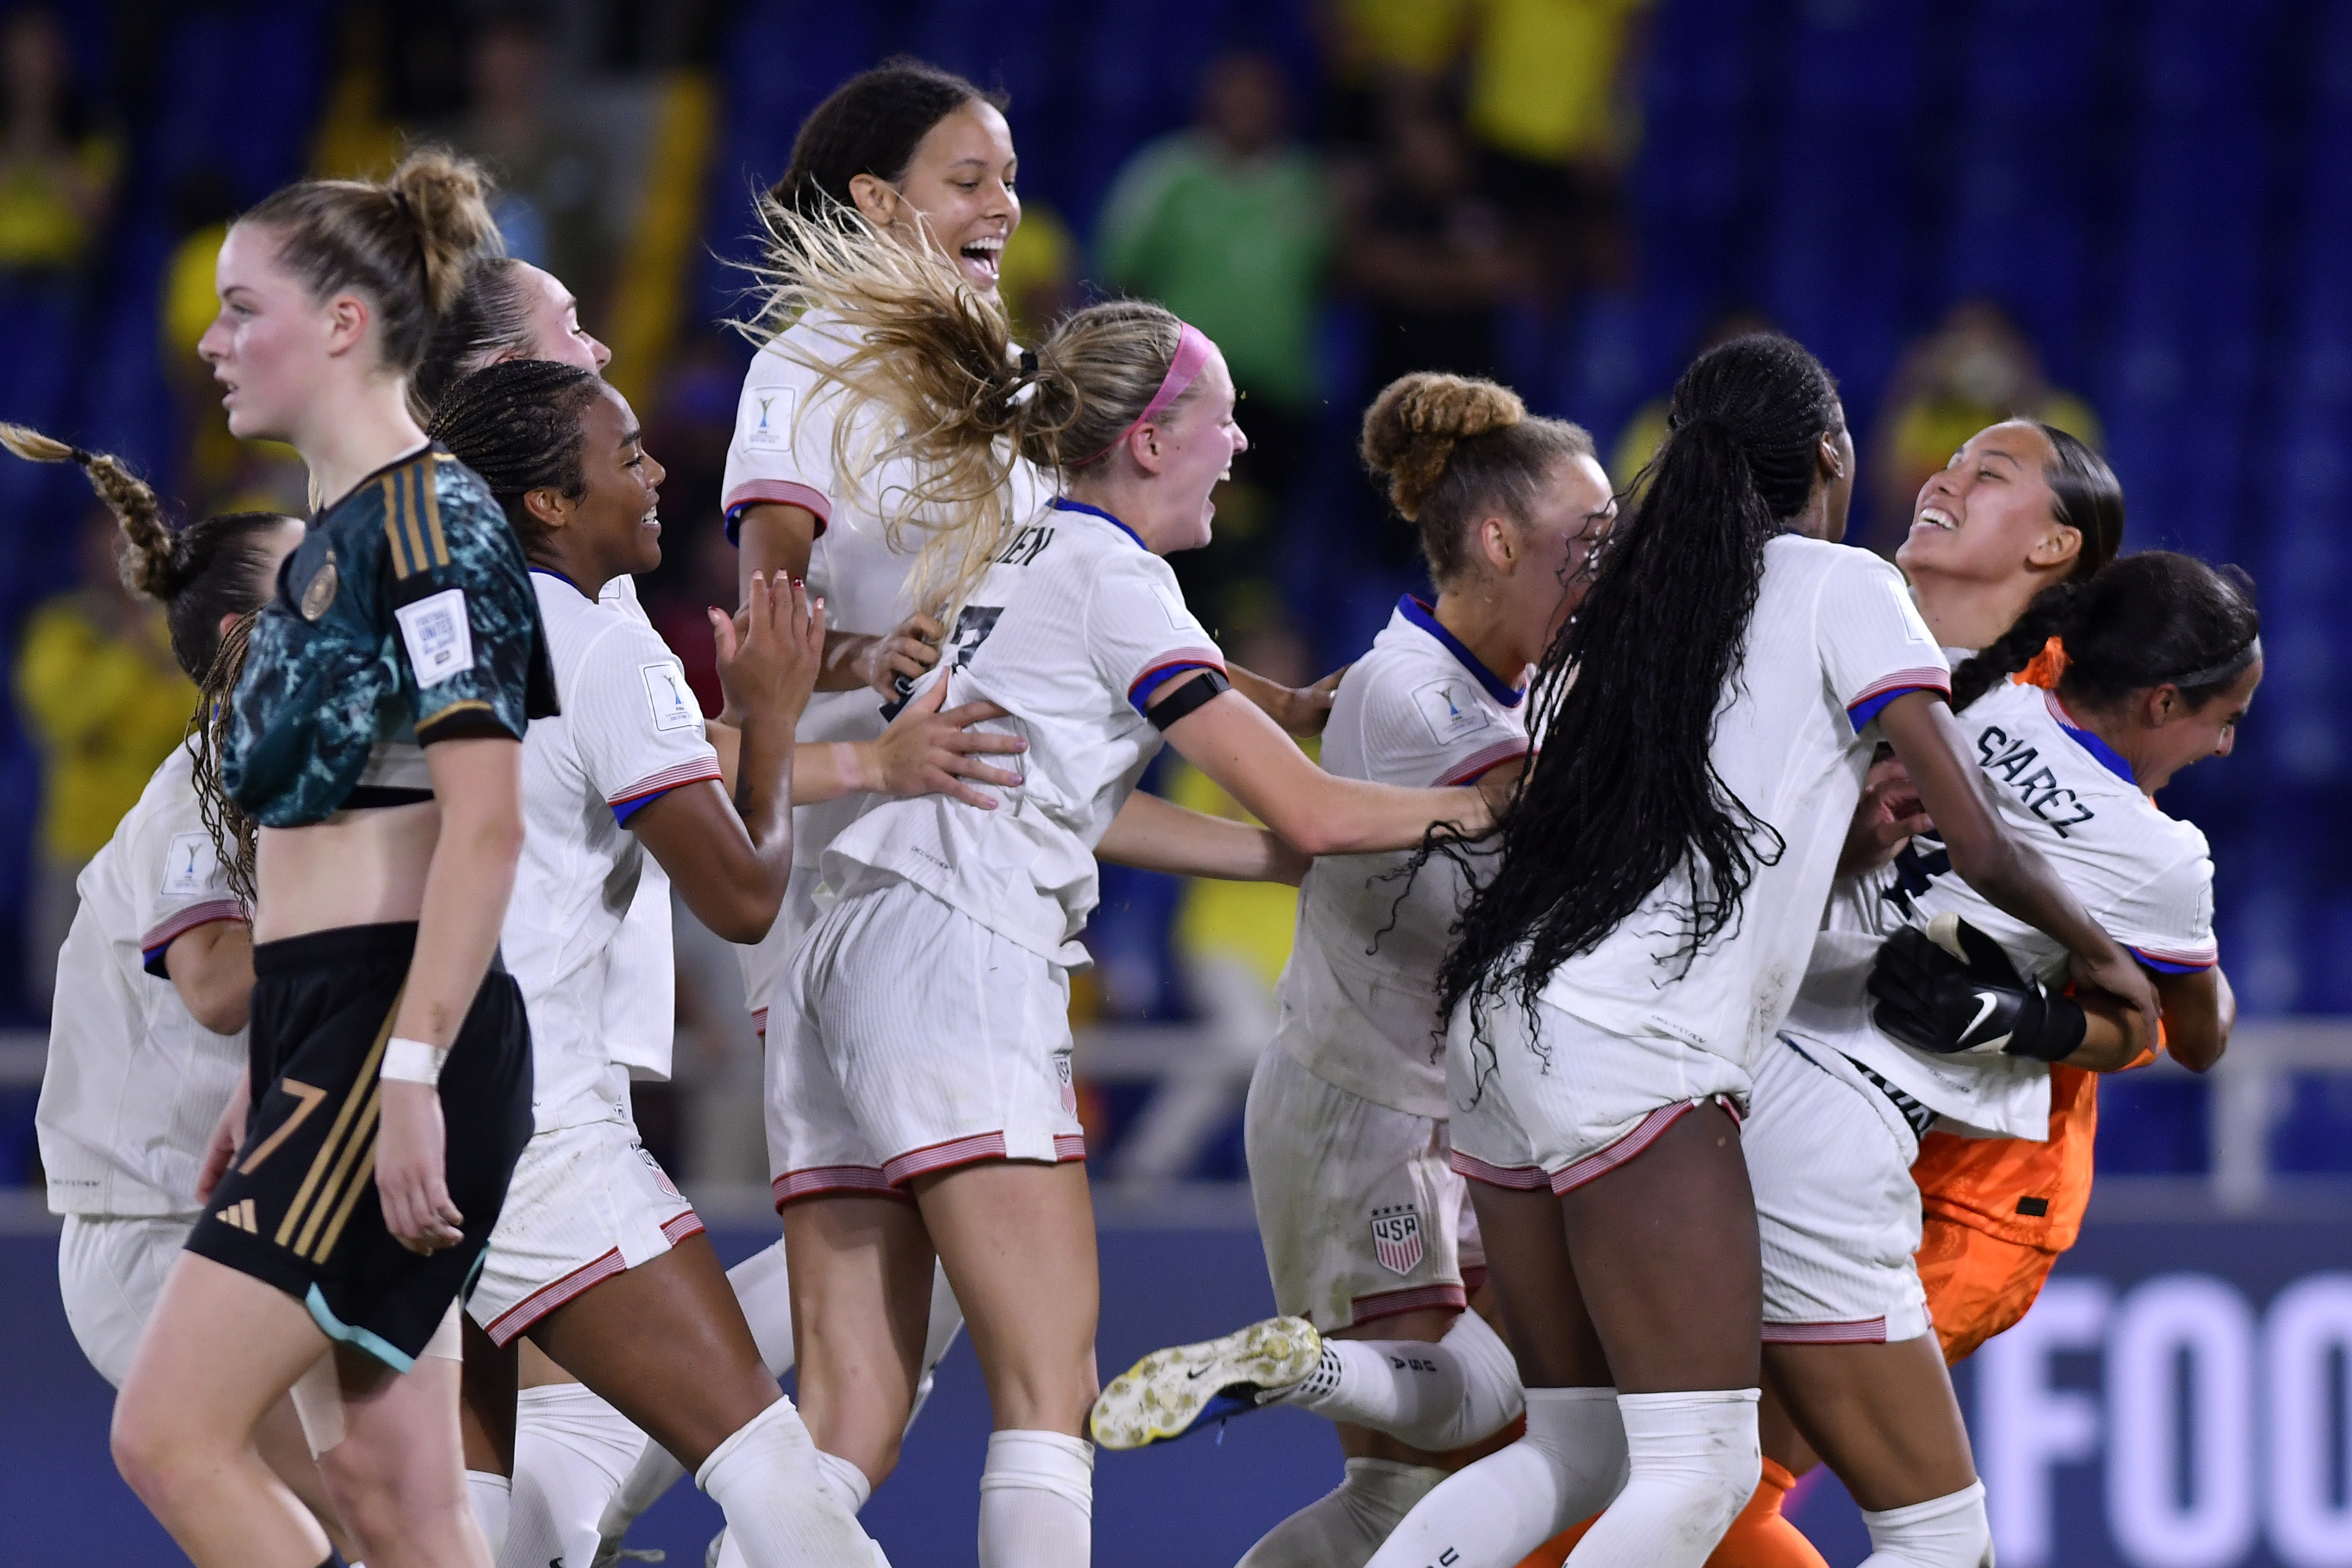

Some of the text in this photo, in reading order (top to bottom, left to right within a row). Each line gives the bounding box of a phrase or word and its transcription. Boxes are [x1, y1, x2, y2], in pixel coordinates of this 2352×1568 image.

[238, 1077, 328, 1175] 7
[639, 1151, 660, 1170] US
[1375, 1217, 1416, 1241] USA
[1390, 1356, 1437, 1371] USA
